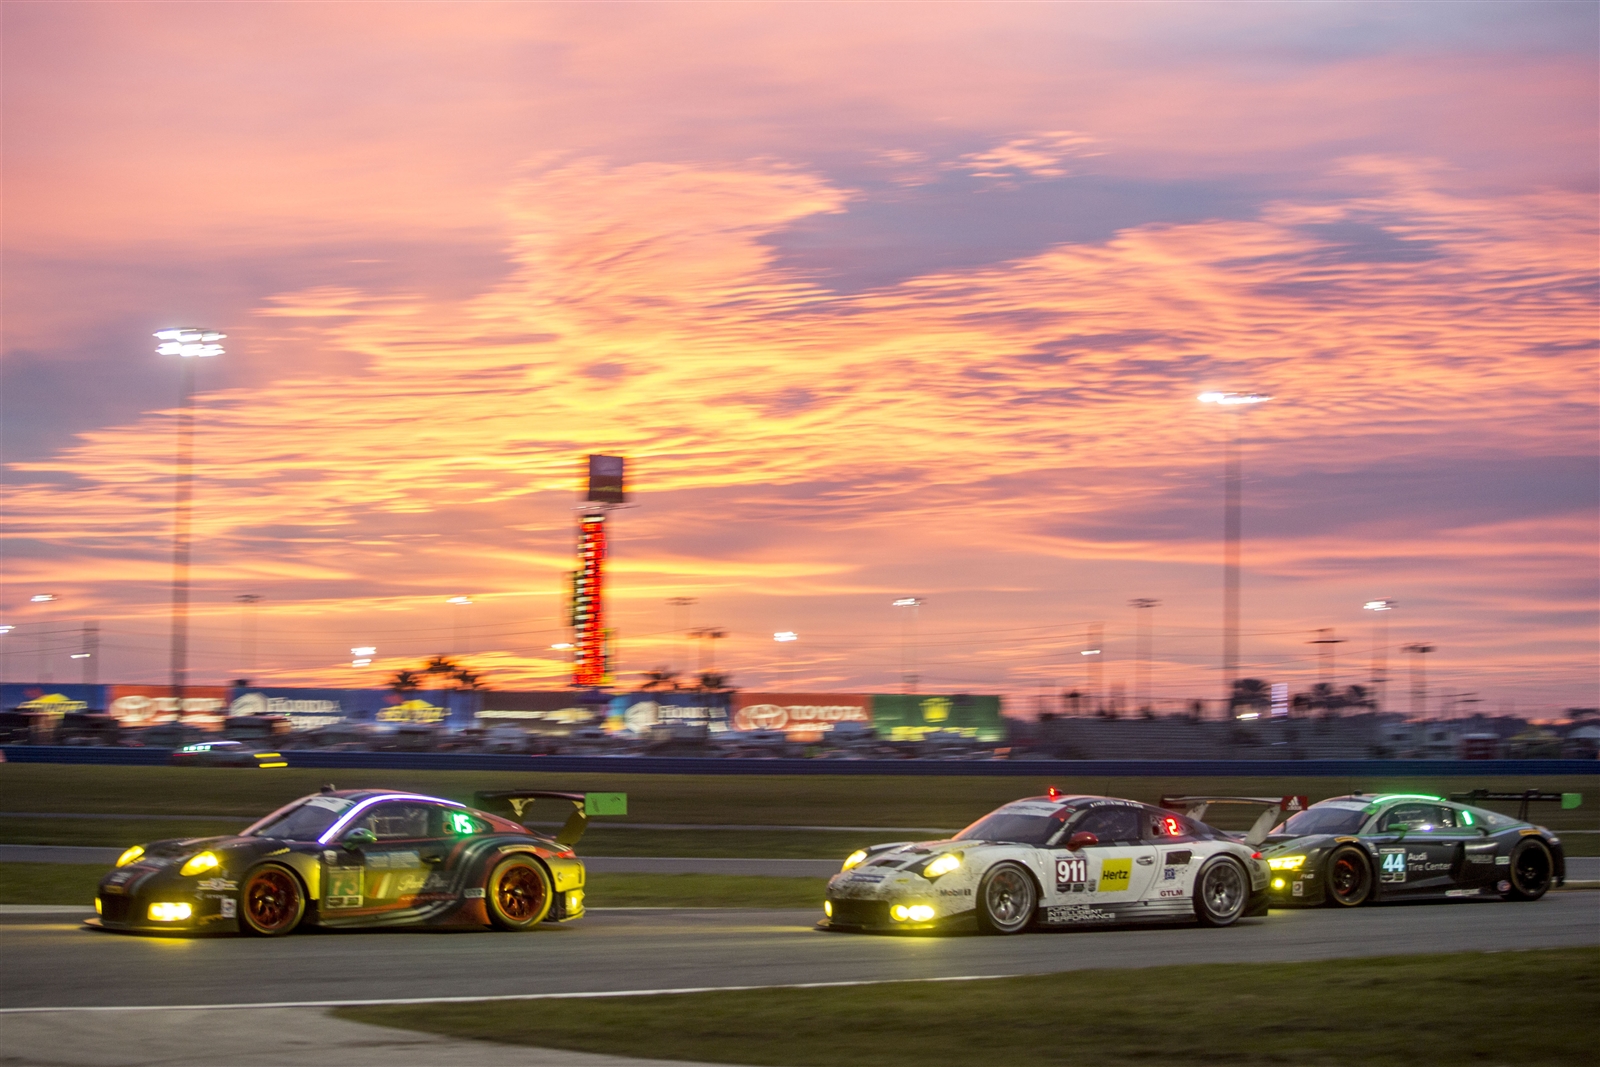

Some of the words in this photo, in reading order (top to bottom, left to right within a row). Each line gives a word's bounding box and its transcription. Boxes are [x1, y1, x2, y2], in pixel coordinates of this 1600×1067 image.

[785, 705, 868, 721] TOYOTA
[1407, 852, 1426, 861] Audi
[1382, 853, 1405, 872] 44
[1407, 862, 1422, 872] Tire
[1424, 861, 1451, 871] Center
[1057, 861, 1085, 882] 911
[1102, 869, 1128, 880] Hertz
[940, 888, 963, 896] Mobil
[1160, 889, 1183, 897] GTLM
